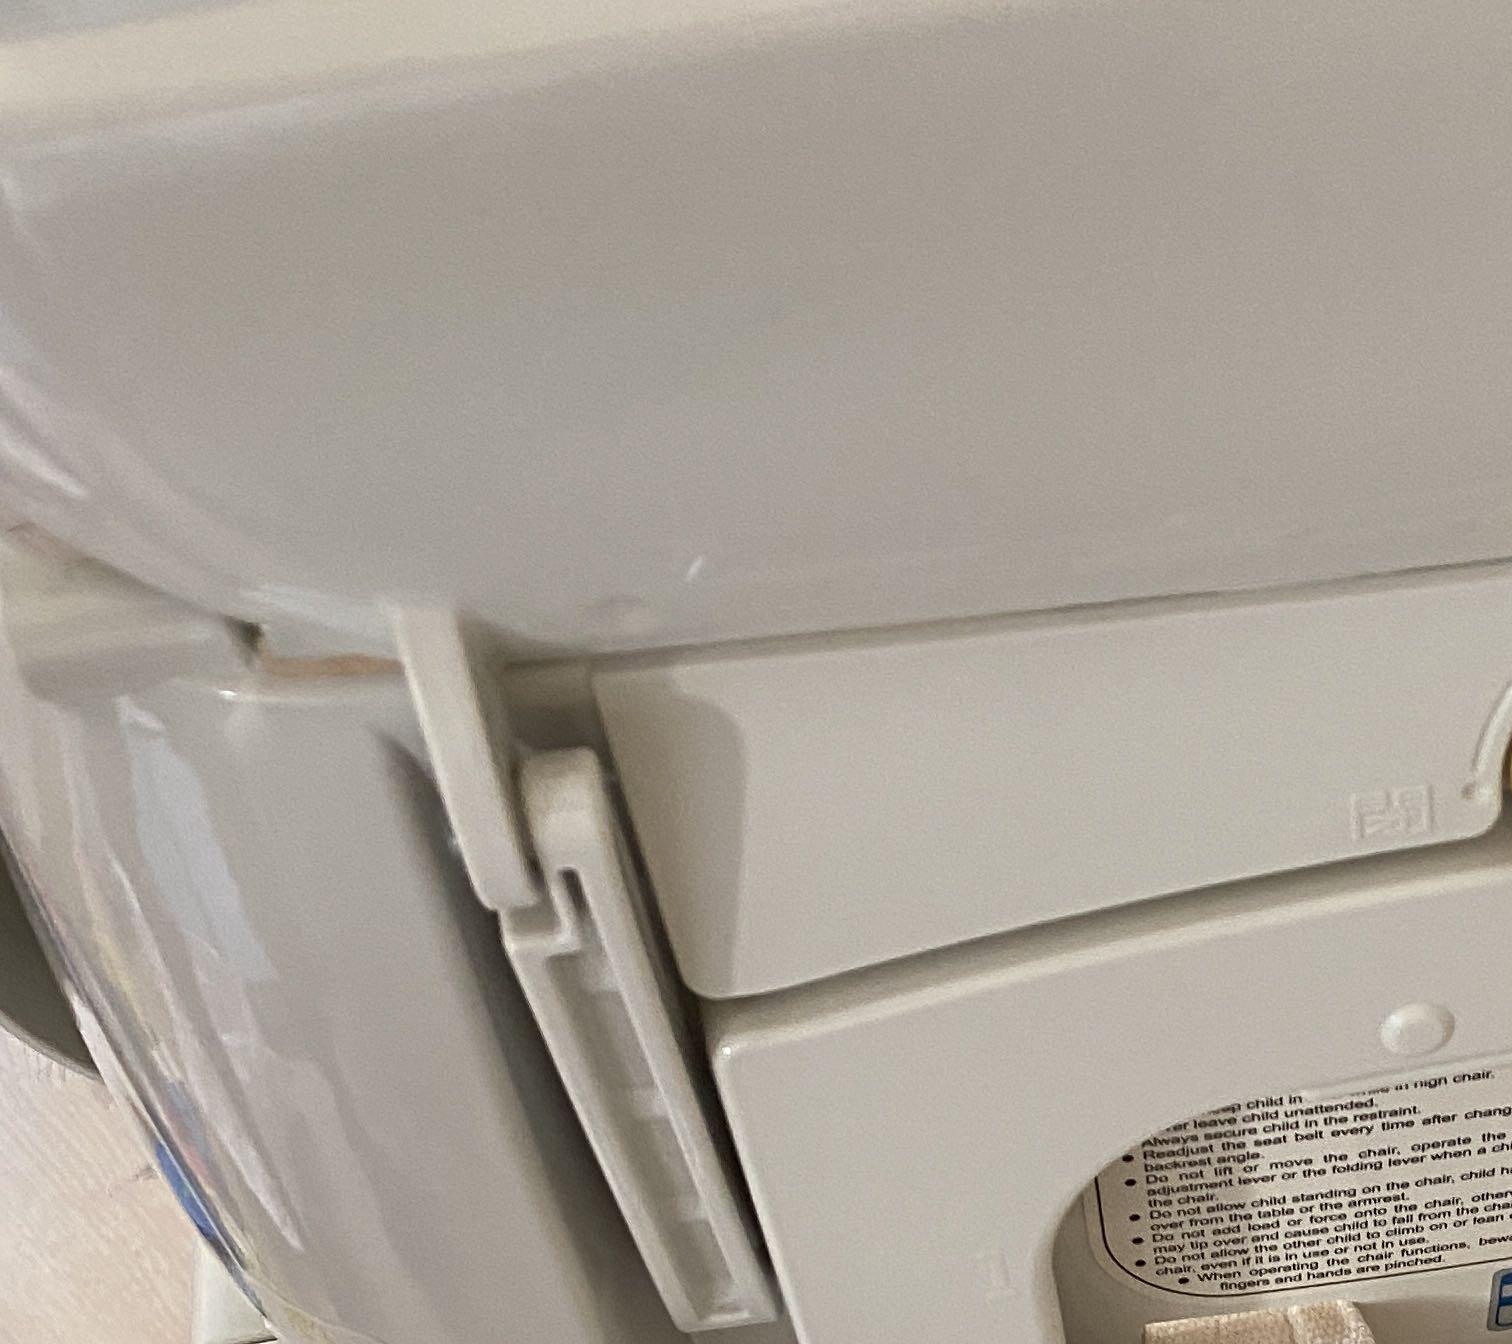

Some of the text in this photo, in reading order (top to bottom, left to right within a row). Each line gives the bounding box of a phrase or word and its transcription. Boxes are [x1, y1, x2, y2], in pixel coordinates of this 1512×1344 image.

[1246, 1096, 1284, 1110] child
[1288, 1094, 1303, 1105] in
[1140, 1134, 1199, 1148] Always
[1203, 1127, 1258, 1141] secure
[1262, 1120, 1300, 1134] child
[1304, 1118, 1319, 1129] in
[1322, 1115, 1349, 1126] the
[1193, 1116, 1237, 1129] leave
[1241, 1109, 1279, 1123] child
[1142, 1144, 1214, 1160] Readjust
[1220, 1140, 1246, 1151] the
[1253, 1134, 1287, 1147] seat
[1294, 1129, 1324, 1143] belt
[1330, 1124, 1374, 1138] every
[1380, 1119, 1415, 1131] time
[1421, 1113, 1458, 1126] after
[1143, 1156, 1212, 1172] backrest
[1145, 1174, 1169, 1185] Do
[1178, 1169, 1204, 1181] not
[1213, 1166, 1233, 1177] lift
[1242, 1163, 1260, 1174] or
[1268, 1158, 1313, 1170] move
[1322, 1153, 1348, 1163] the
[1410, 1136, 1472, 1152] operate
[1481, 1132, 1507, 1143] the
[1146, 1178, 1234, 1196] adjustment
[1237, 1174, 1277, 1185] lever
[1280, 1171, 1298, 1181] or
[1302, 1168, 1327, 1178] the
[1331, 1160, 1383, 1174] folding
[1388, 1154, 1427, 1168] lever
[1430, 1148, 1472, 1161] when
[1476, 1146, 1487, 1155] a
[1147, 1198, 1173, 1208] the
[1148, 1209, 1172, 1220] Do
[1176, 1205, 1202, 1217] not
[1206, 1202, 1246, 1214] allow
[1250, 1195, 1287, 1208] child
[1291, 1188, 1357, 1203] standing
[1361, 1184, 1381, 1195] on
[1385, 1181, 1410, 1191] the
[1459, 1167, 1496, 1181] child
[1149, 1220, 1184, 1231] over
[1188, 1216, 1224, 1227] from
[1228, 1212, 1253, 1223] the
[1256, 1206, 1295, 1219] table
[1298, 1204, 1315, 1214] or
[1318, 1201, 1343, 1212] the
[1151, 1232, 1174, 1243] Do
[1180, 1229, 1205, 1240] not
[1211, 1224, 1241, 1236] add
[1247, 1218, 1280, 1232] load
[1286, 1218, 1303, 1227] or
[1308, 1212, 1347, 1224] force
[1353, 1207, 1387, 1218] onto
[1393, 1203, 1418, 1214] the
[1152, 1242, 1186, 1255] may
[1189, 1240, 1209, 1251] tip
[1212, 1235, 1248, 1247] over
[1250, 1230, 1279, 1243] and
[1284, 1226, 1329, 1239] cause
[1333, 1219, 1369, 1232] child
[1372, 1218, 1387, 1227] to
[1391, 1213, 1414, 1226] fall
[1417, 1210, 1452, 1222] from
[1455, 1206, 1479, 1217] the
[1154, 1255, 1177, 1266] Do
[1181, 1250, 1205, 1262] not
[1210, 1247, 1250, 1260] allow
[1253, 1243, 1278, 1254] the
[1282, 1238, 1322, 1250] other
[1326, 1232, 1361, 1245] child
[1366, 1230, 1381, 1240] to
[1384, 1224, 1425, 1237] climb
[1428, 1222, 1448, 1231] on
[1452, 1218, 1469, 1228] or
[1472, 1213, 1504, 1225] lean
[1200, 1260, 1238, 1271] even
[1241, 1256, 1251, 1267] if
[1254, 1255, 1264, 1265] it
[1268, 1254, 1281, 1263] is
[1284, 1251, 1298, 1261] in
[1302, 1249, 1330, 1259] use
[1333, 1245, 1350, 1255] or
[1353, 1241, 1377, 1253] not
[1380, 1239, 1395, 1250] in
[1196, 1270, 1242, 1282] When
[1248, 1261, 1319, 1277] operating
[1326, 1257, 1350, 1267] the
[1356, 1250, 1394, 1263] chair
[1219, 1278, 1270, 1290] fingers
[1274, 1272, 1302, 1285] and
[1306, 1267, 1352, 1281] hands
[1355, 1264, 1380, 1274] are
